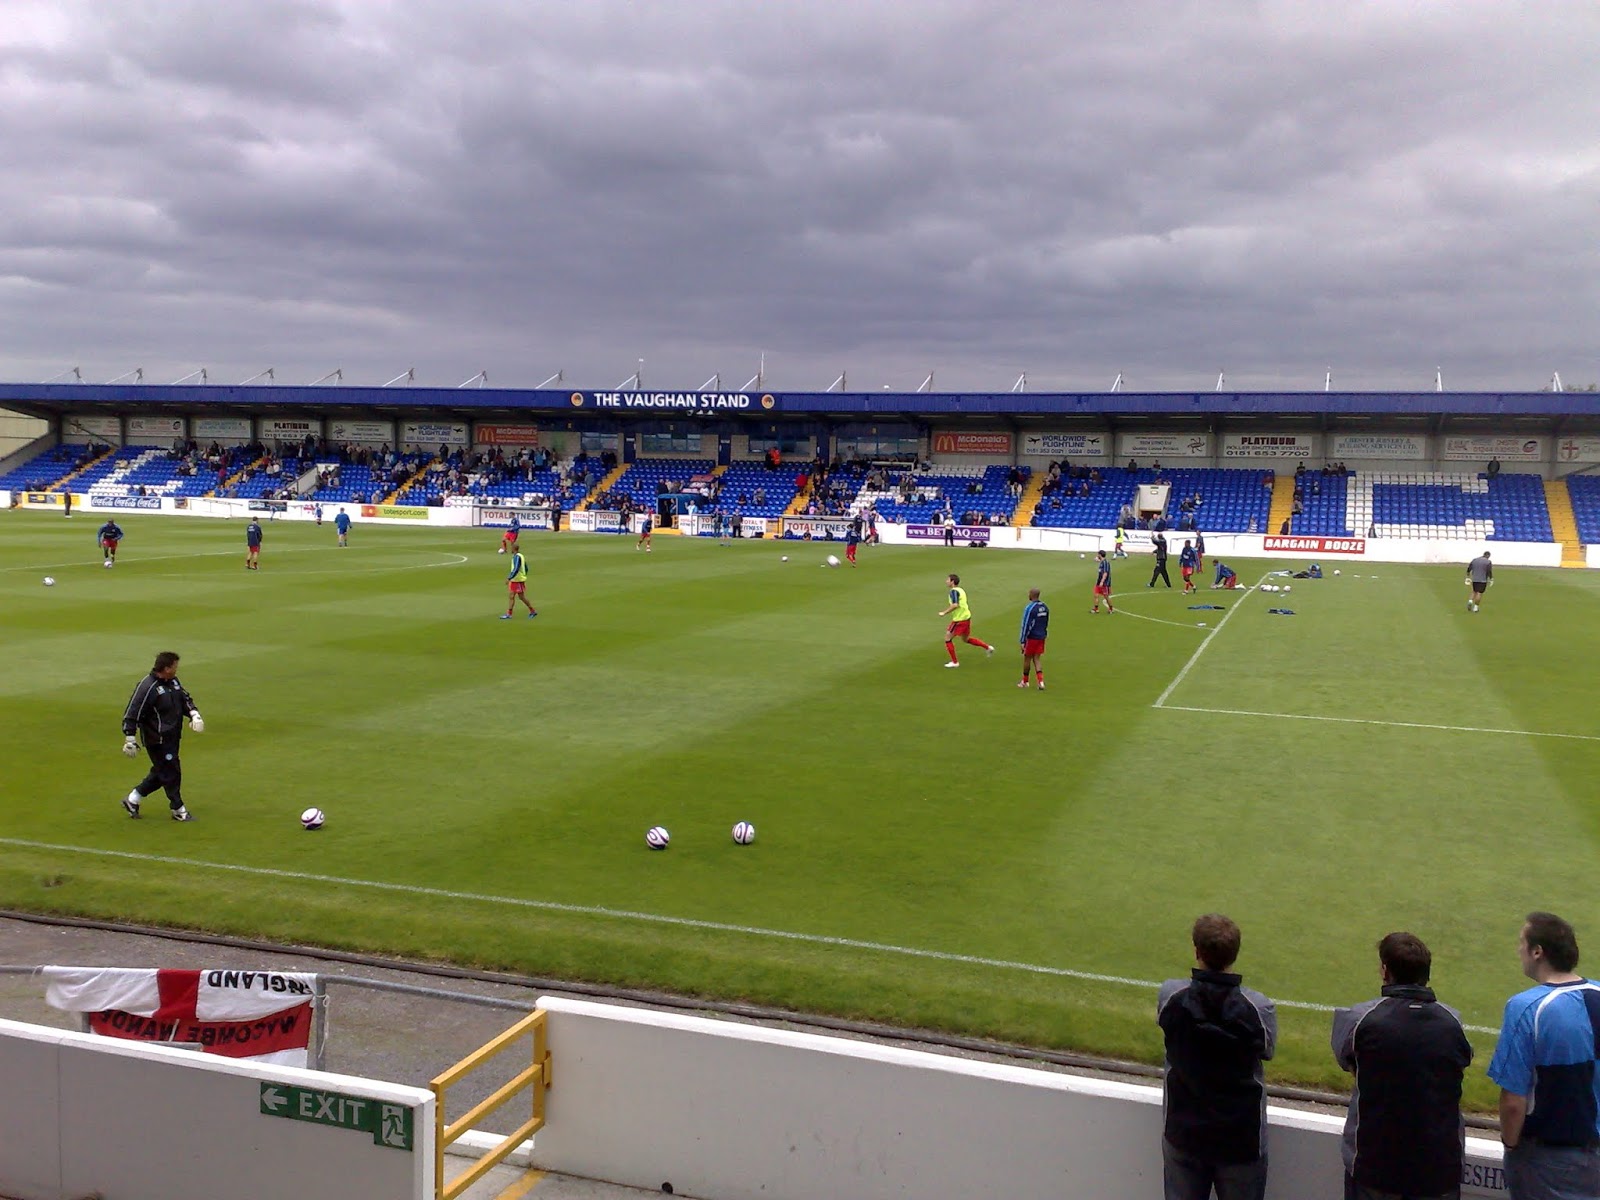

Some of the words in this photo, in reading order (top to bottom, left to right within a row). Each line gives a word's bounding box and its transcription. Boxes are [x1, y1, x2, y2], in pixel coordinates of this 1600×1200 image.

[594, 393, 620, 406] THE
[624, 393, 696, 407] VAUGHAN
[701, 395, 749, 408] STAND
[1241, 437, 1296, 445] PLATINUM
[383, 508, 427, 516] totesport.com
[1265, 539, 1320, 549] BARGAIN
[1324, 540, 1364, 551] BOOZE
[186, 1016, 296, 1046] WYCOMBE
[300, 1092, 366, 1125] EXIT
